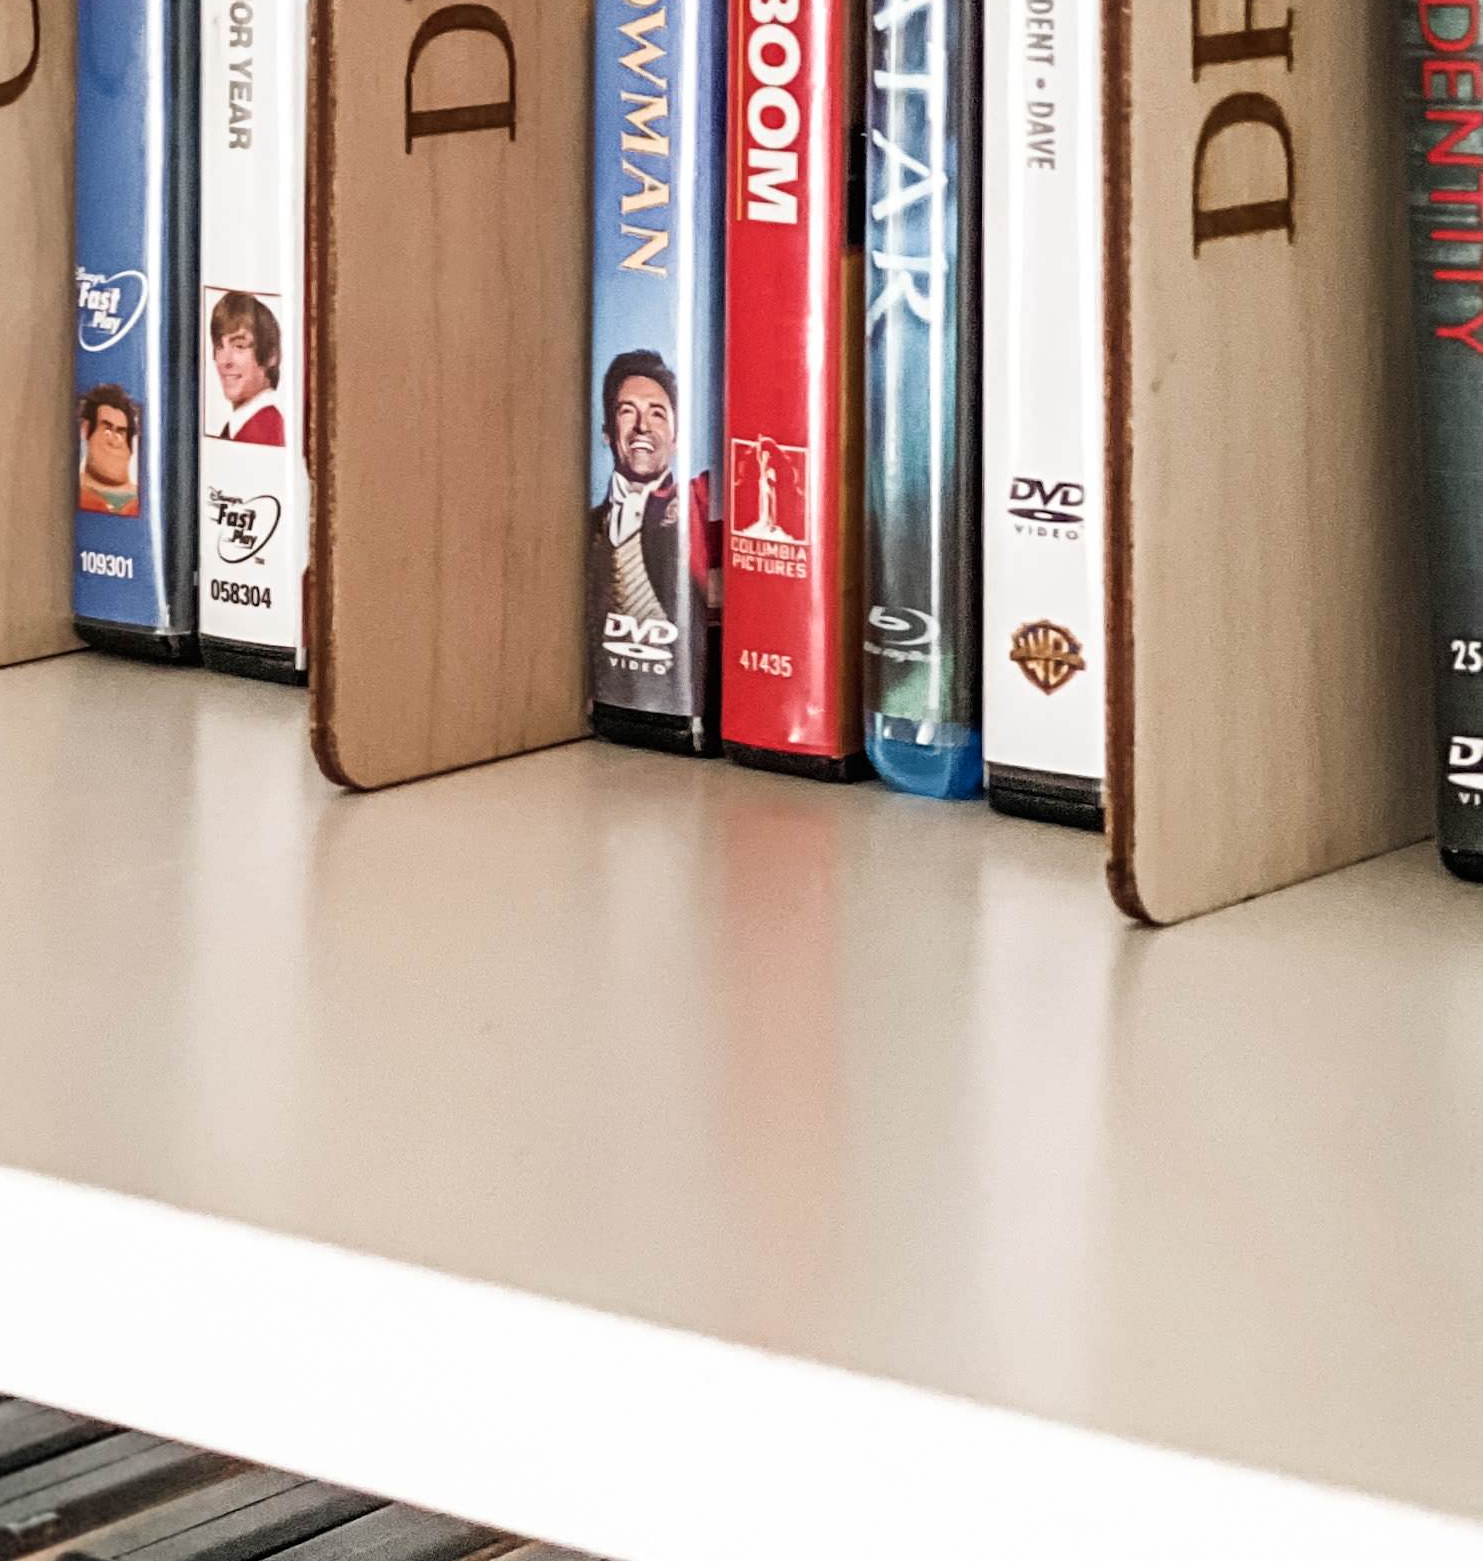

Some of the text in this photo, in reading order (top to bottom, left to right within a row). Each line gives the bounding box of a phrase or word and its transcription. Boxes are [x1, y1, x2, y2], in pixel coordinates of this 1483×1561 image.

[227, 58, 254, 149] YEAR
[1026, 101, 1055, 171] DAVE
[1010, 477, 1084, 507] DVD
[217, 503, 256, 531] Fast
[1014, 524, 1079, 541] VIDEO
[730, 536, 807, 562] COLUMBIA
[80, 550, 134, 579] 109301
[732, 555, 807, 579] PICTURES
[210, 578, 272, 609] 058304
[604, 612, 679, 646] DVD
[609, 657, 668, 676] VIDEO
[739, 648, 793, 679] 41435
